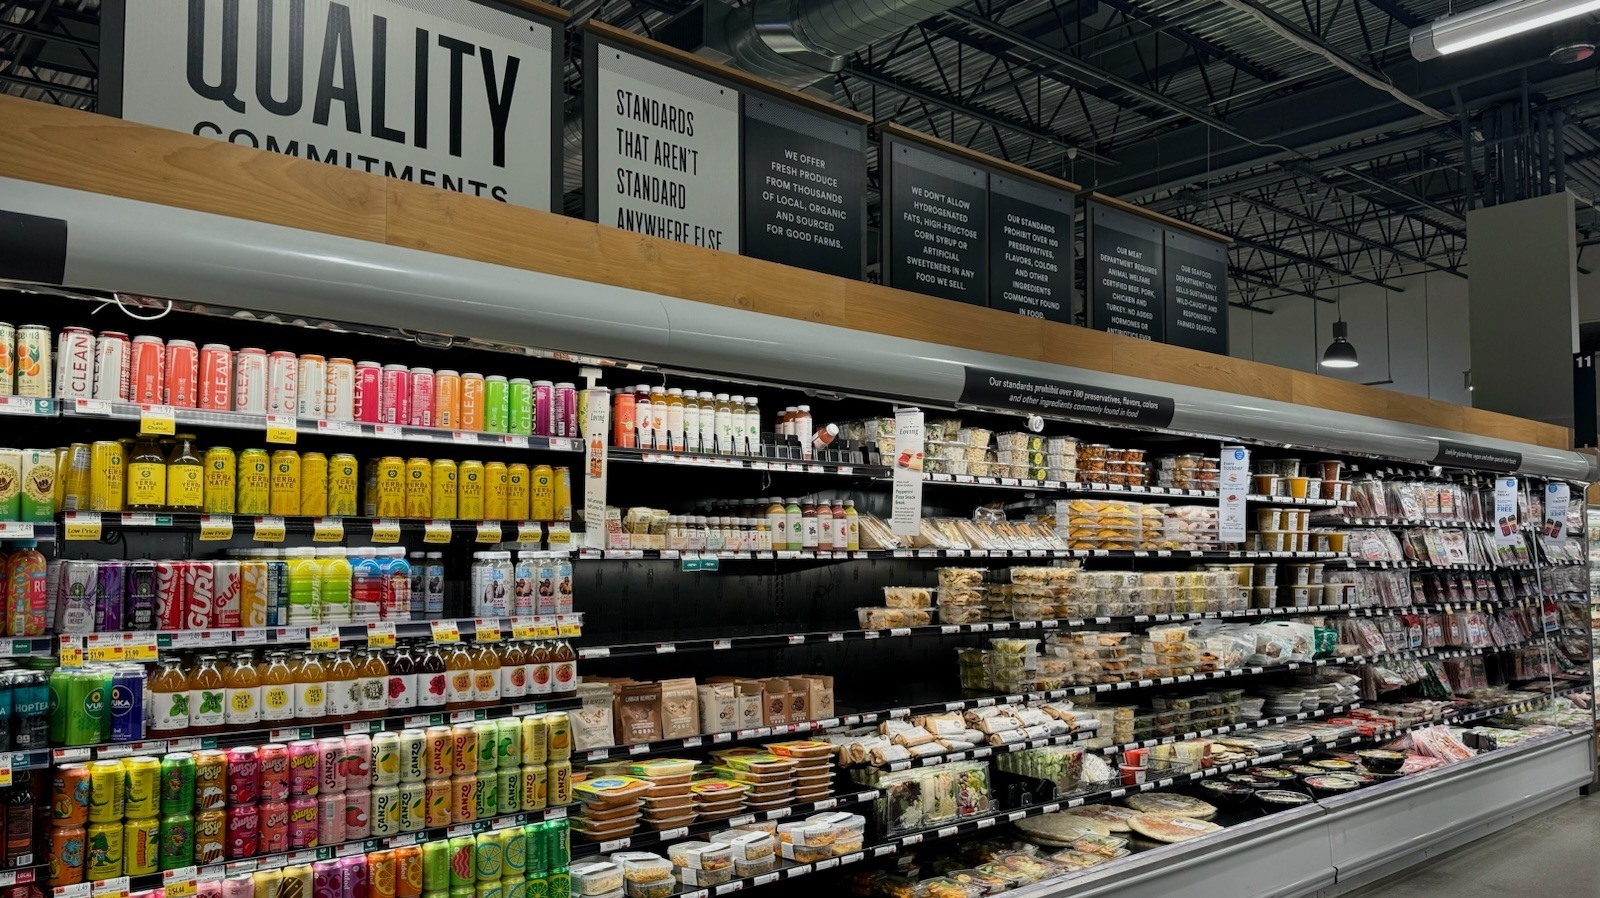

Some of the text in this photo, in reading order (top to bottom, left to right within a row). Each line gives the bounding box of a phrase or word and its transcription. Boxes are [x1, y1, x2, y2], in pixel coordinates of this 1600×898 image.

[186, 0, 520, 168] QUALITY
[617, 89, 693, 136] STANDARDS
[617, 128, 698, 175] THAT AREN'T
[785, 150, 825, 168] WE OFFER
[772, 162, 837, 187] FRESH PRODUCE
[618, 168, 685, 209] STANDARD
[766, 176, 842, 203] FROM THOUSANDS
[912, 186, 970, 209] WE DON'T ALLOW
[763, 191, 846, 219] OF LOCAL, ORGANIC
[914, 201, 968, 222] HYDROGENATED
[618, 207, 722, 251] ANYWHERE ELSE
[776, 211, 834, 231] AND SOURCED
[904, 212, 976, 239] FATS, HIGH-FRUCTOSE
[1008, 214, 1055, 234] OUR STANDARDS
[767, 224, 843, 248] FOR GOOD FARMS.
[915, 230, 967, 249] CORN SYRUP OR
[1004, 226, 1031, 239] PROHIBIT
[1032, 234, 1047, 244] OVER
[907, 256, 951, 273] SWEETENERS
[961, 269, 974, 278] ANY
[923, 246, 959, 261] ARTIFICIAL
[1006, 253, 1057, 272] FLAVORS, COLORS
[916, 272, 966, 290] FOOD WE SELL.
[1013, 281, 1051, 295] INGREDIENTS
[1015, 269, 1048, 282] AND OTHER
[1004, 292, 1060, 310] COMMONLY FOUND
[72, 336, 88, 392] CLEAN
[215, 353, 228, 406] CLEAN
[284, 360, 295, 410] CLEAN
[989, 377, 1002, 386] Our
[1003, 380, 1033, 392] standards
[1034, 384, 1058, 395] prohibit
[1084, 392, 1121, 404] preservatives,
[1123, 397, 1141, 407] flavors,
[1142, 400, 1158, 409] colors
[463, 380, 474, 424] CLEAN
[522, 385, 530, 430] CLEAN
[1022, 396, 1039, 404] other
[1039, 397, 1073, 409] ingredients
[1073, 404, 1103, 414] commonly
[1103, 406, 1120, 415] found
[1126, 409, 1139, 418] food
[228, 763, 257, 777] SunSip
[291, 755, 318, 769] SunSip
[325, 752, 336, 788] SANZO
[412, 742, 422, 777] SANZO
[434, 739, 444, 774] SANZO
[509, 776, 517, 808] SANZO
[527, 774, 536, 807] SANZO
[378, 796, 388, 832] SANZO
